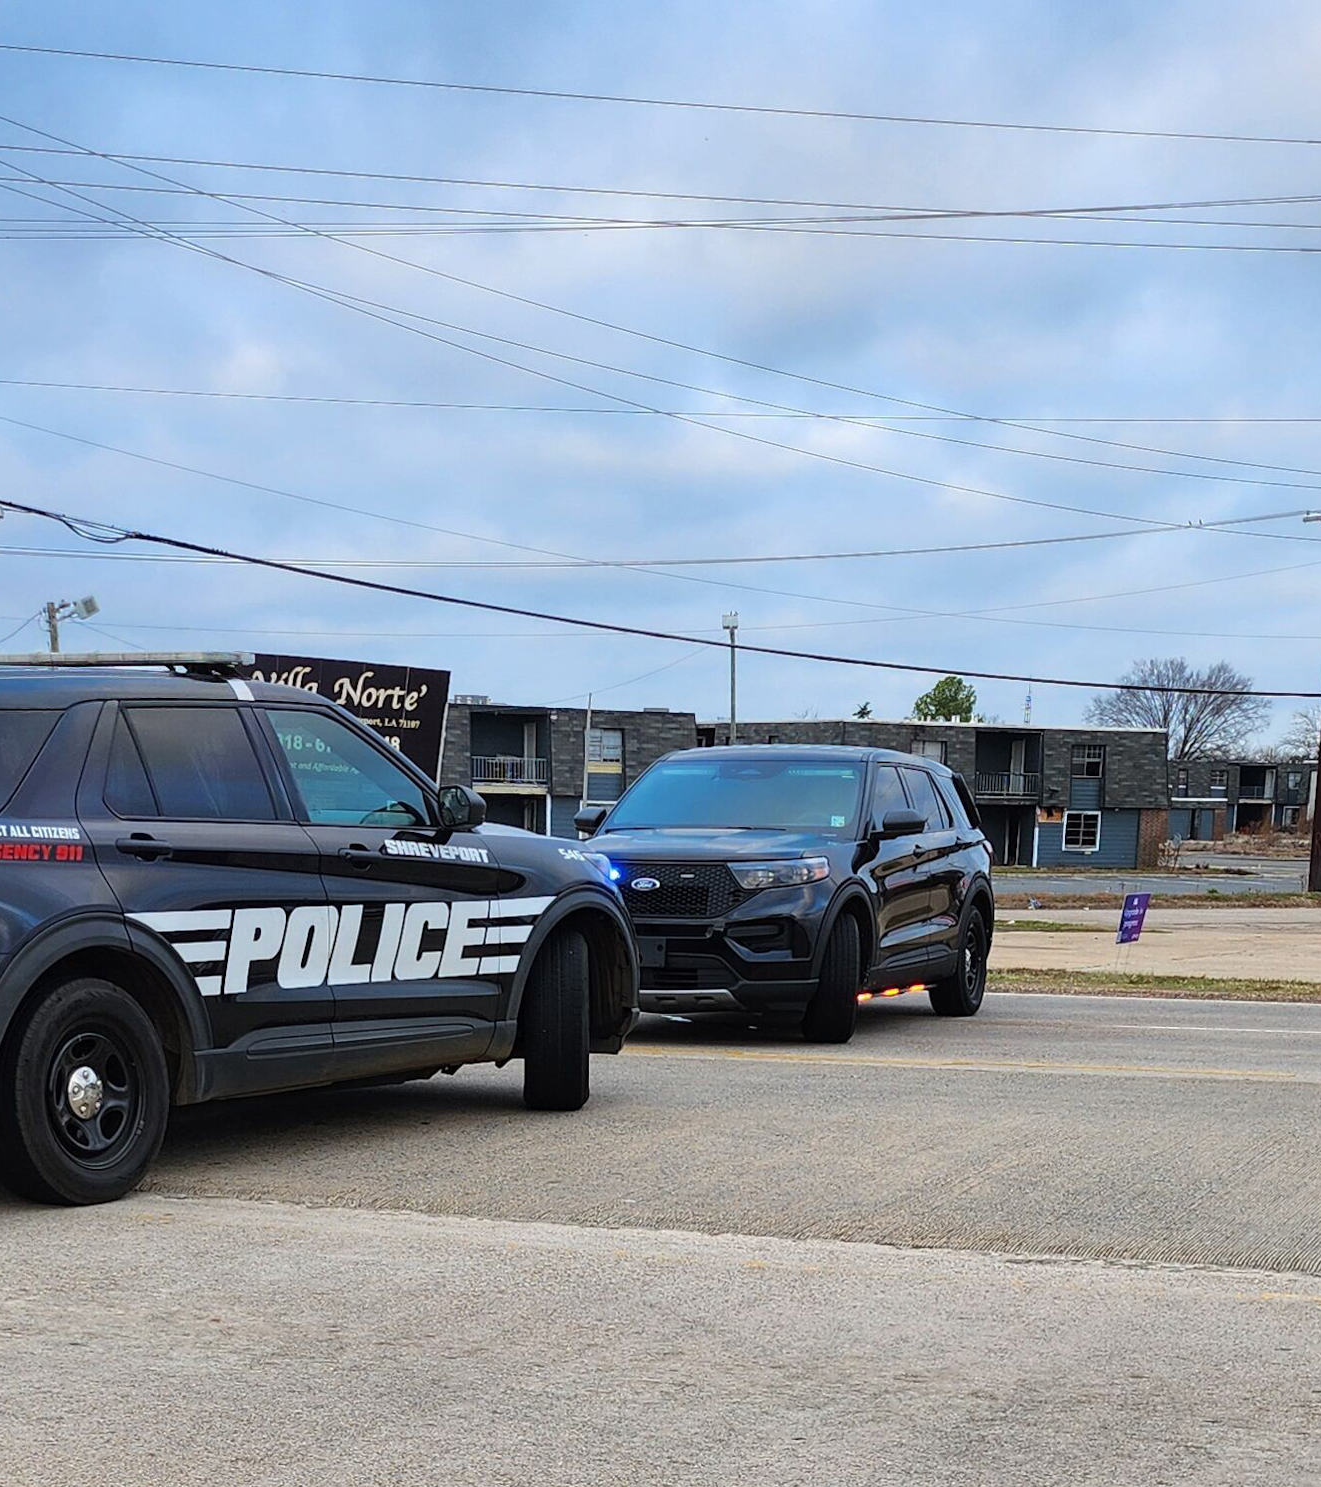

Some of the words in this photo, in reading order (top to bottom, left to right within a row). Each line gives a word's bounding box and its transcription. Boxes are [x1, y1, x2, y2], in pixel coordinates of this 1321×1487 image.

[384, 717, 397, 727] LA
[10, 824, 31, 838] ALL
[31, 826, 80, 839] CITIZENS
[56, 845, 83, 861] 911
[384, 839, 489, 863] SHREVEPORT
[224, 900, 491, 995] POLICE
